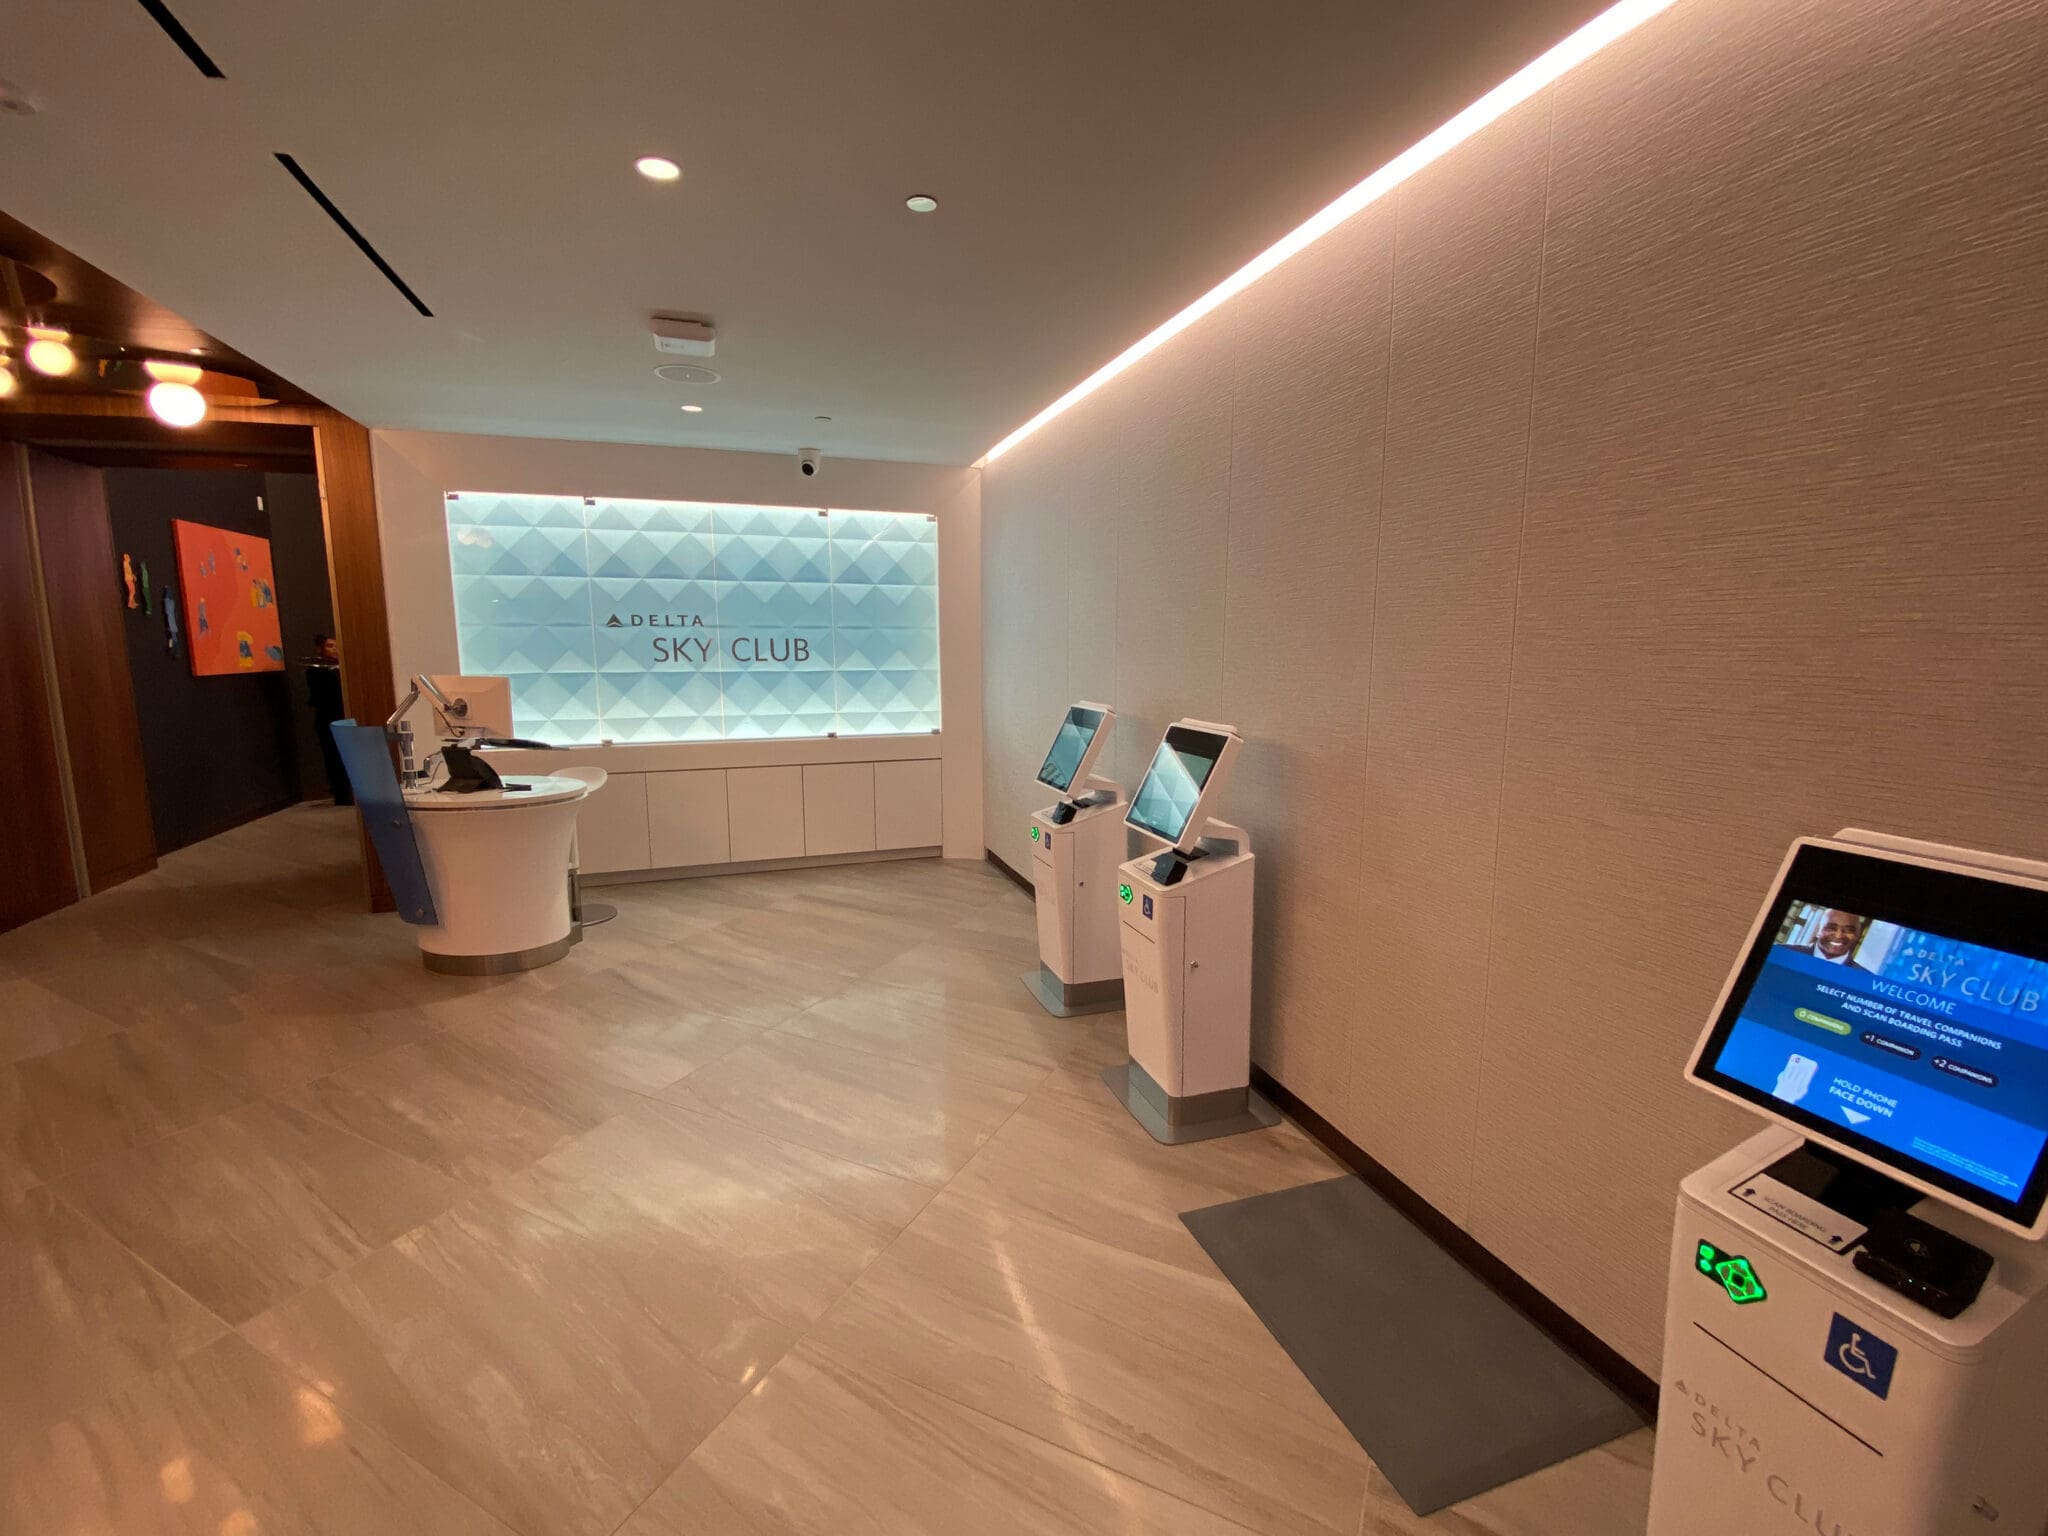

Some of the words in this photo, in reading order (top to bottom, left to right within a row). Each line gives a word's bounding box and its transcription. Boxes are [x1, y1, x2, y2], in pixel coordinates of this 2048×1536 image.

[630, 614, 704, 627] DELTA
[653, 637, 713, 662] SKY
[732, 637, 810, 662] CLUB
[1872, 979, 1957, 1015] WELCOME
[1907, 963, 1957, 989] SKY
[1961, 976, 2040, 1012] CLUB
[1816, 984, 1846, 999] SELECT
[1846, 994, 1884, 1012] NUMBER
[1884, 1006, 1898, 1016] OF
[1899, 1010, 1932, 1028] TRAVEL
[1934, 1022, 2003, 1050] COMPANIONS
[1841, 1002, 1862, 1014] AND
[1862, 1009, 1888, 1023] SCAN
[1888, 1017, 1937, 1039] BOARDING
[1937, 1033, 1963, 1048] PASS
[1934, 1058, 1947, 1068] +2
[1828, 1085, 1855, 1102] FACE
[1856, 1097, 1893, 1118] DOWN
[1833, 1077, 1861, 1093] HOLD
[1862, 1088, 1898, 1109] PHONE
[1695, 1392, 1760, 1452] DELTA
[1690, 1411, 1756, 1473] SKY
[1767, 1474, 1854, 1536] CLU
